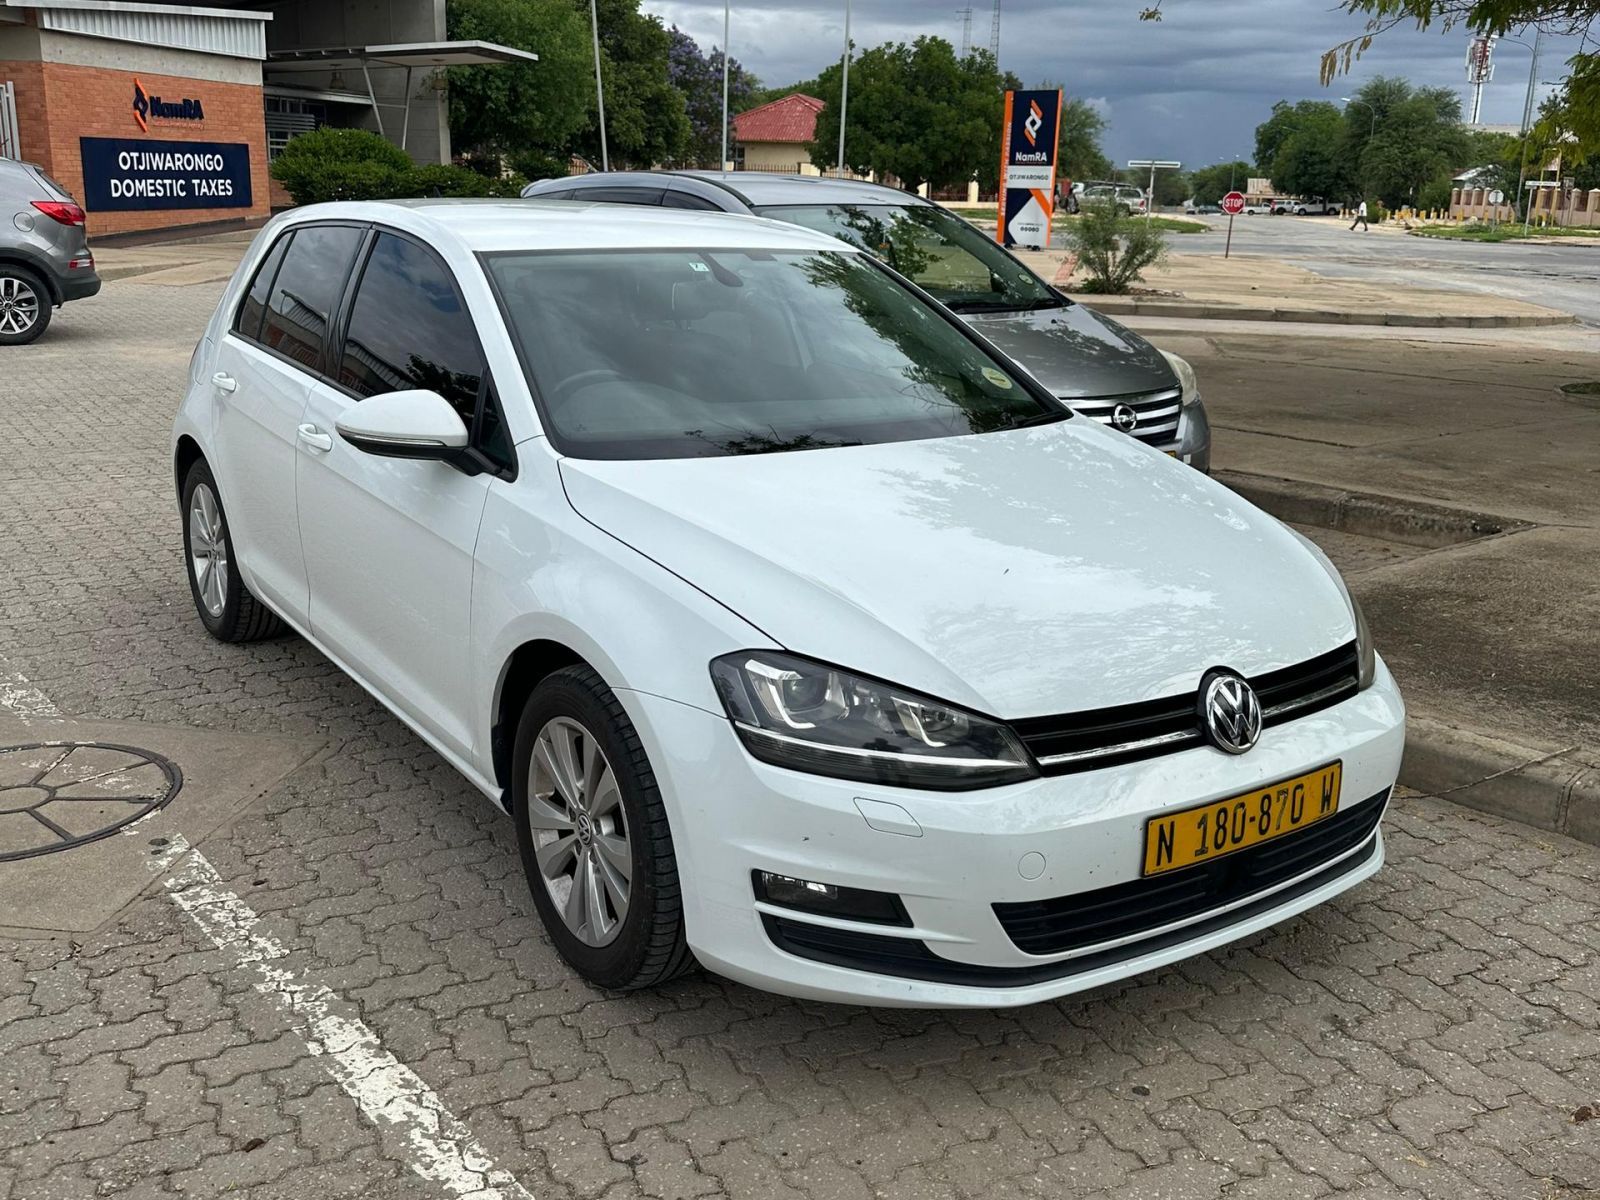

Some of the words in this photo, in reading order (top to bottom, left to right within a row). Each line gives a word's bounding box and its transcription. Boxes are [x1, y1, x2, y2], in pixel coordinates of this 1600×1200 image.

[149, 96, 204, 120] NamRA
[118, 151, 224, 171] OTJIWARONGO
[1015, 152, 1048, 162] NamRA
[110, 179, 187, 198] DOMESTIC
[192, 179, 233, 196] TAXES
[1225, 199, 1243, 208] STOP
[1156, 821, 1175, 867] N
[1194, 783, 1305, 857] 180-870
[1320, 772, 1335, 813] W
